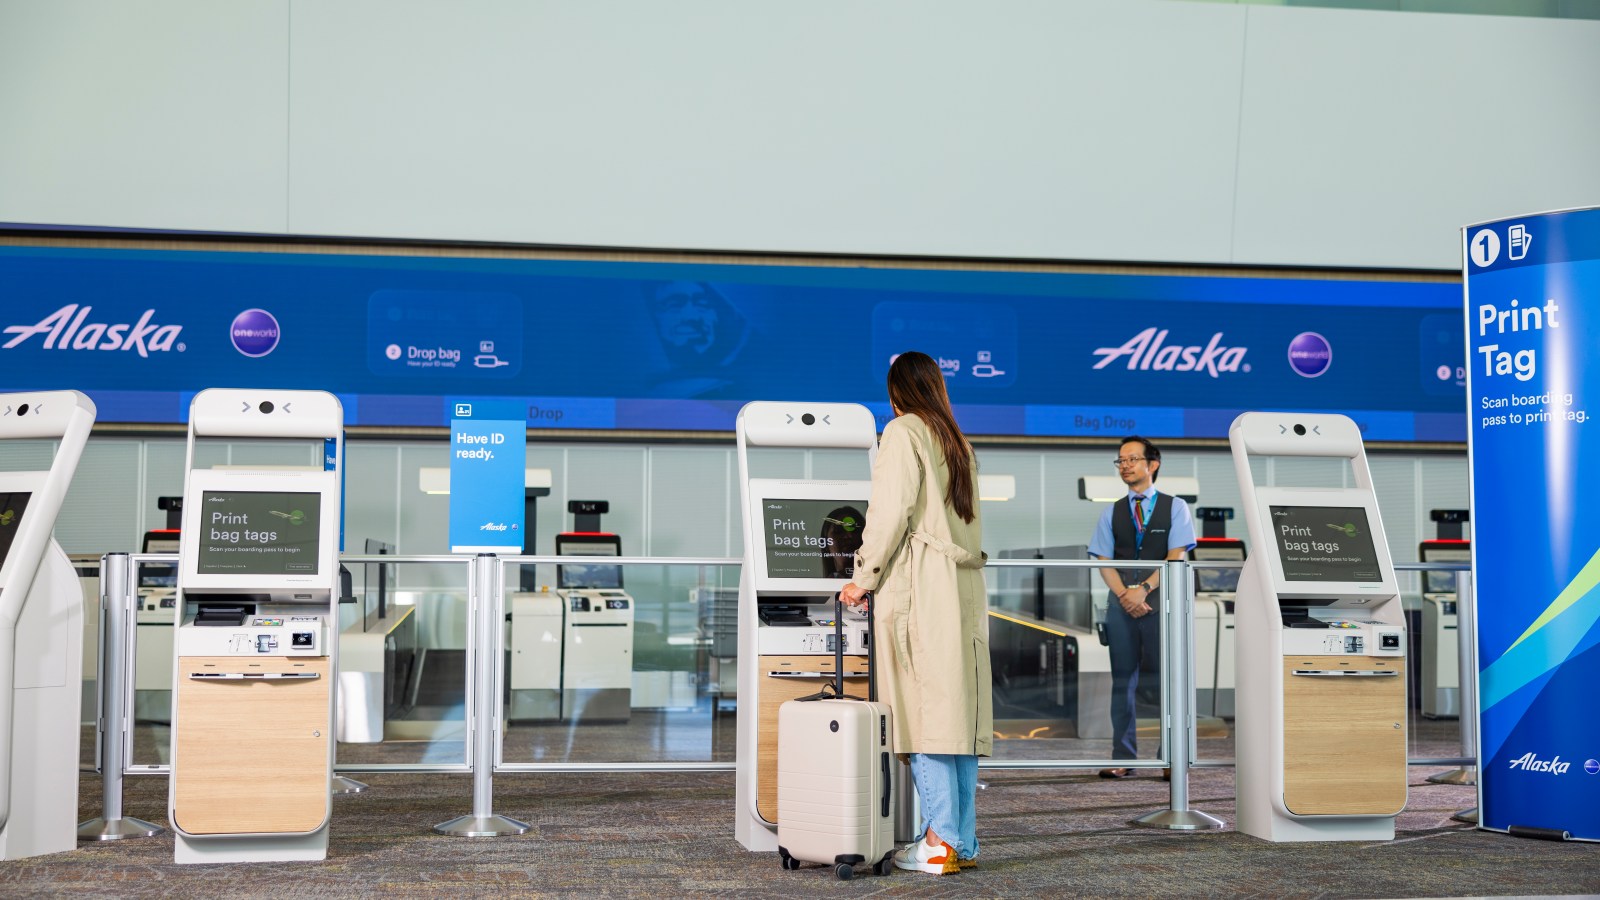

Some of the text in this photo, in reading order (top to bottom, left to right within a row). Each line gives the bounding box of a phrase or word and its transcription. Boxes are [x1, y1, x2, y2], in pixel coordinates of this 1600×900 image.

[1478, 234, 1490, 262] 1
[1479, 299, 1560, 336] Print
[233, 329, 277, 338] oneworld
[408, 345, 437, 361] Drop
[438, 346, 461, 363] bag
[938, 356, 961, 372] bag
[1478, 344, 1536, 382] Tag
[1482, 391, 1573, 409] Scan boarding
[528, 406, 564, 422] Drop
[1482, 414, 1507, 429] pass
[1509, 411, 1522, 424] to
[1562, 409, 1590, 424] tag.
[1074, 415, 1137, 432] Bag Drop
[456, 432, 505, 445] Have ID
[456, 447, 495, 461] ready.
[212, 511, 249, 525] Print
[773, 518, 806, 531] Print
[479, 522, 508, 532] Alaska
[1281, 525, 1312, 537] Print
[210, 528, 278, 544] bag tags
[773, 534, 834, 549] bag tags
[1284, 539, 1340, 554] bag tags
[1509, 752, 1571, 776] Alaska
